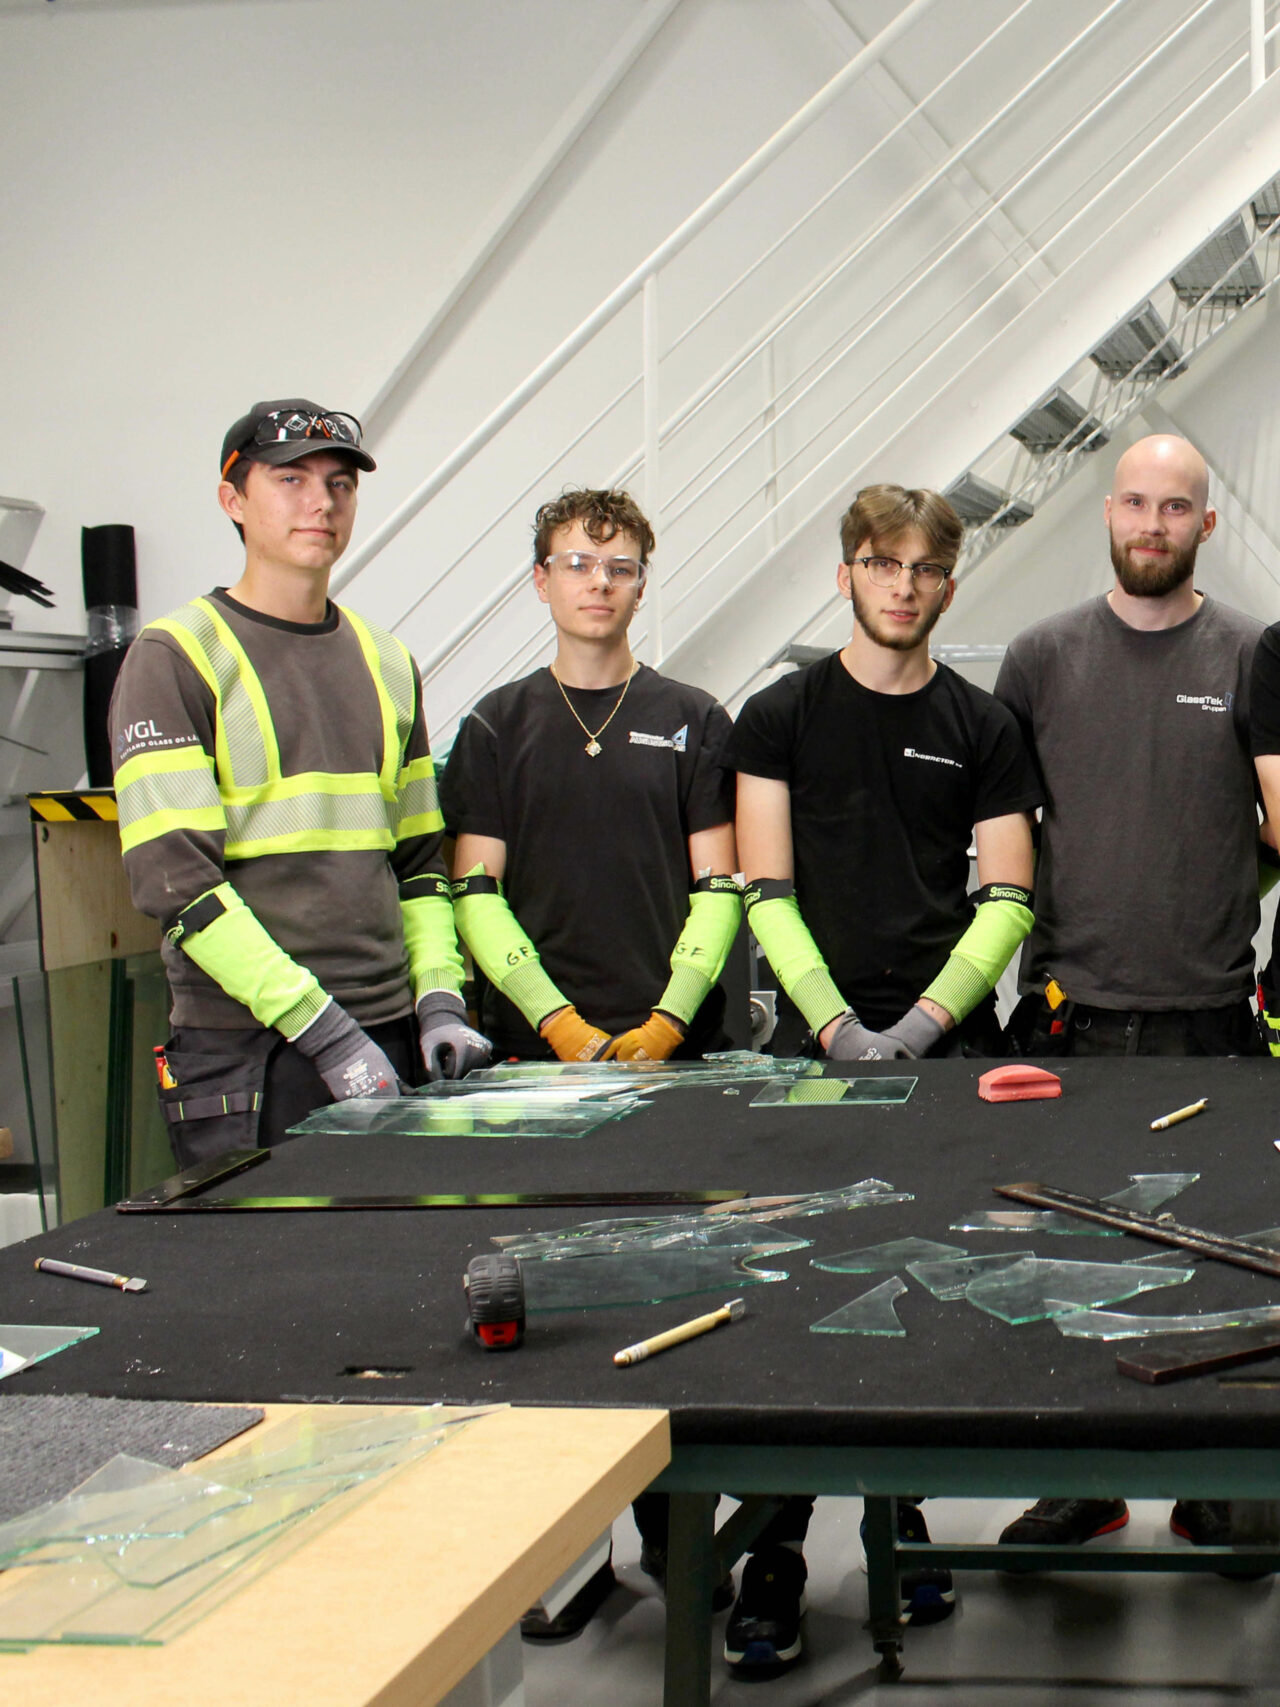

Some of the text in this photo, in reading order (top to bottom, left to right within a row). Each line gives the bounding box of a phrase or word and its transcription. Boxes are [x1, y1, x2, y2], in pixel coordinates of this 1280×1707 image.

[1176, 694, 1223, 706] GlassTek
[123, 719, 163, 743] VGL
[148, 738, 173, 747] GLASS
